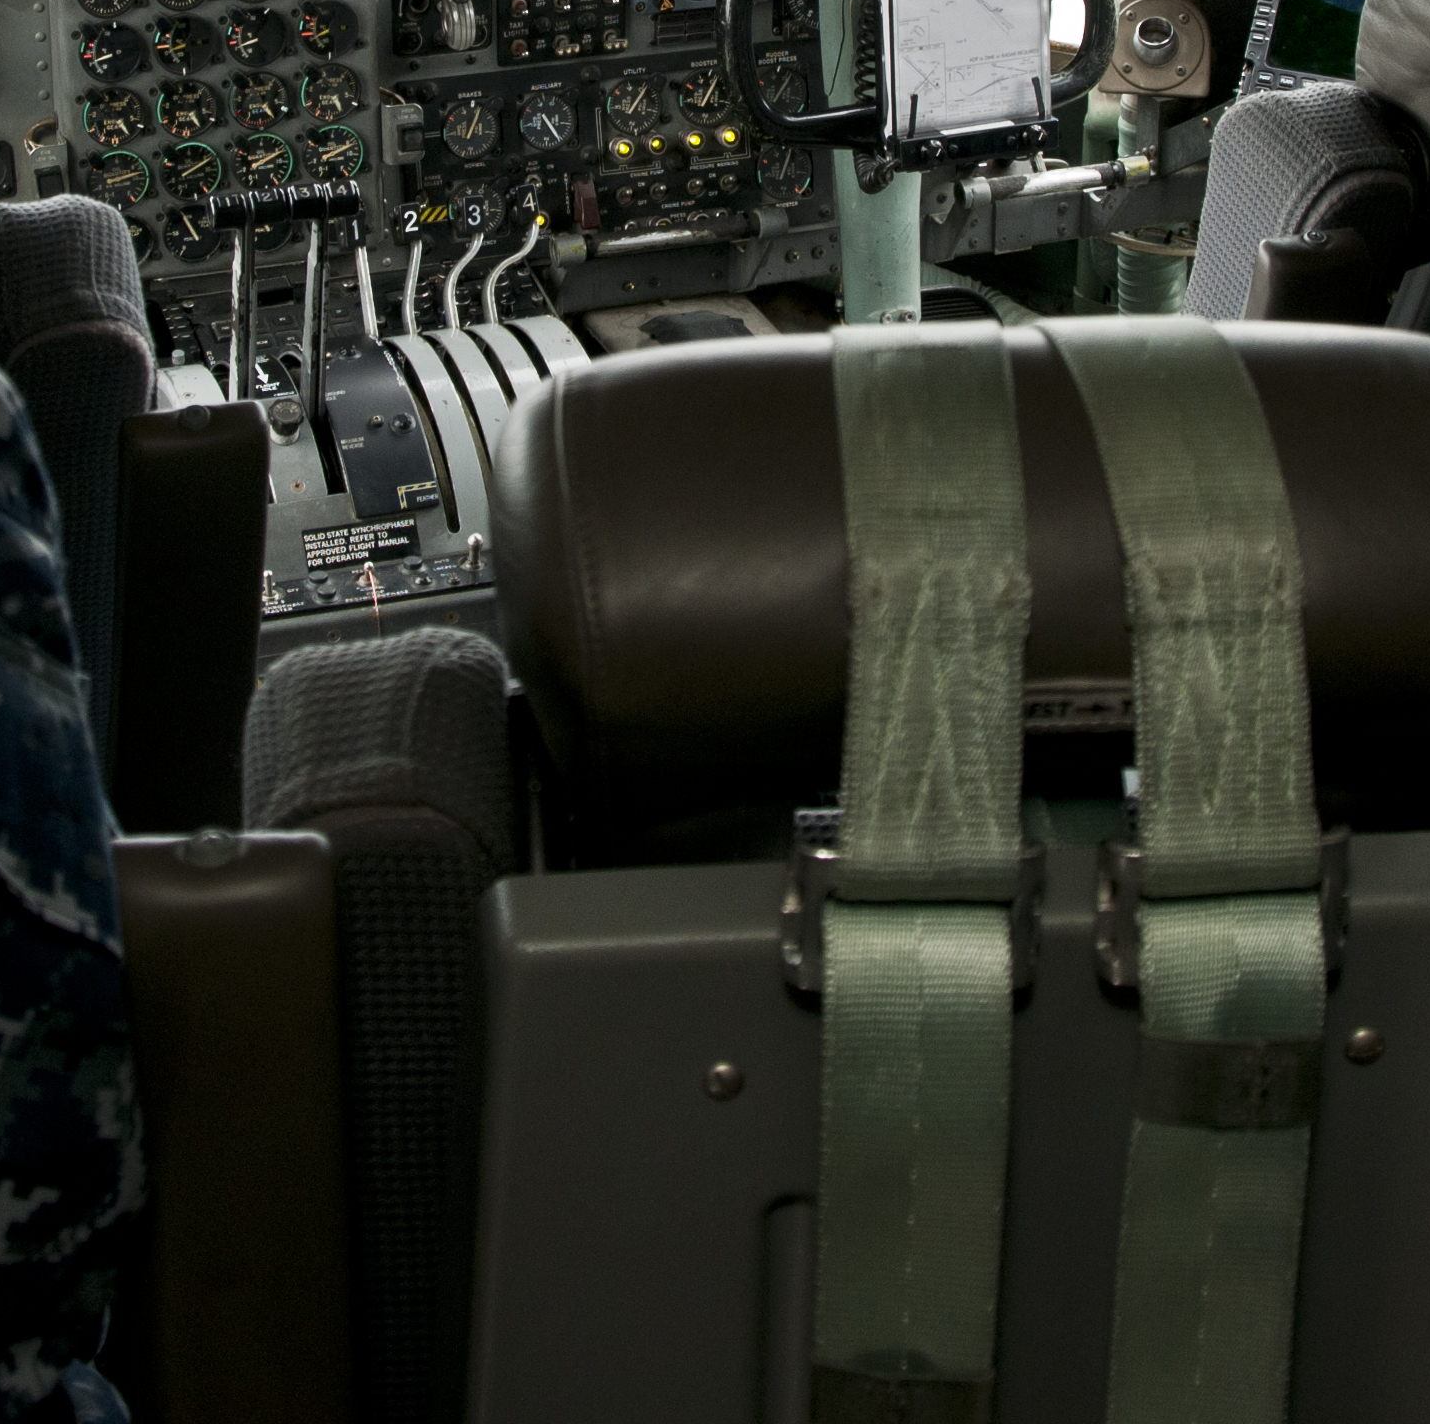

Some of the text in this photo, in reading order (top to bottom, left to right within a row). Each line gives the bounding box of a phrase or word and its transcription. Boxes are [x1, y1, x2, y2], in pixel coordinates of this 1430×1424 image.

[758, 55, 798, 65] BOOST PRESS
[765, 51, 789, 59] RUDDER
[690, 59, 718, 68] BOOSTER
[623, 67, 646, 76] UTILITY
[530, 81, 562, 91] AUXILIARY
[457, 90, 483, 99] BRAKES
[298, 187, 310, 198] 3
[336, 184, 348, 195] 4
[261, 191, 273, 202] 2
[522, 191, 537, 212] 4
[468, 204, 481, 226] 3
[403, 210, 419, 233] 2
[351, 219, 359, 241] 1
[303, 518, 415, 543] SOLID STATE SYNCHROPHASER
[349, 532, 375, 544] REFER
[377, 530, 388, 539] TO
[306, 536, 411, 560] APPROVED FLIGHT MANUAL
[307, 550, 369, 568] FOR OPERATION
